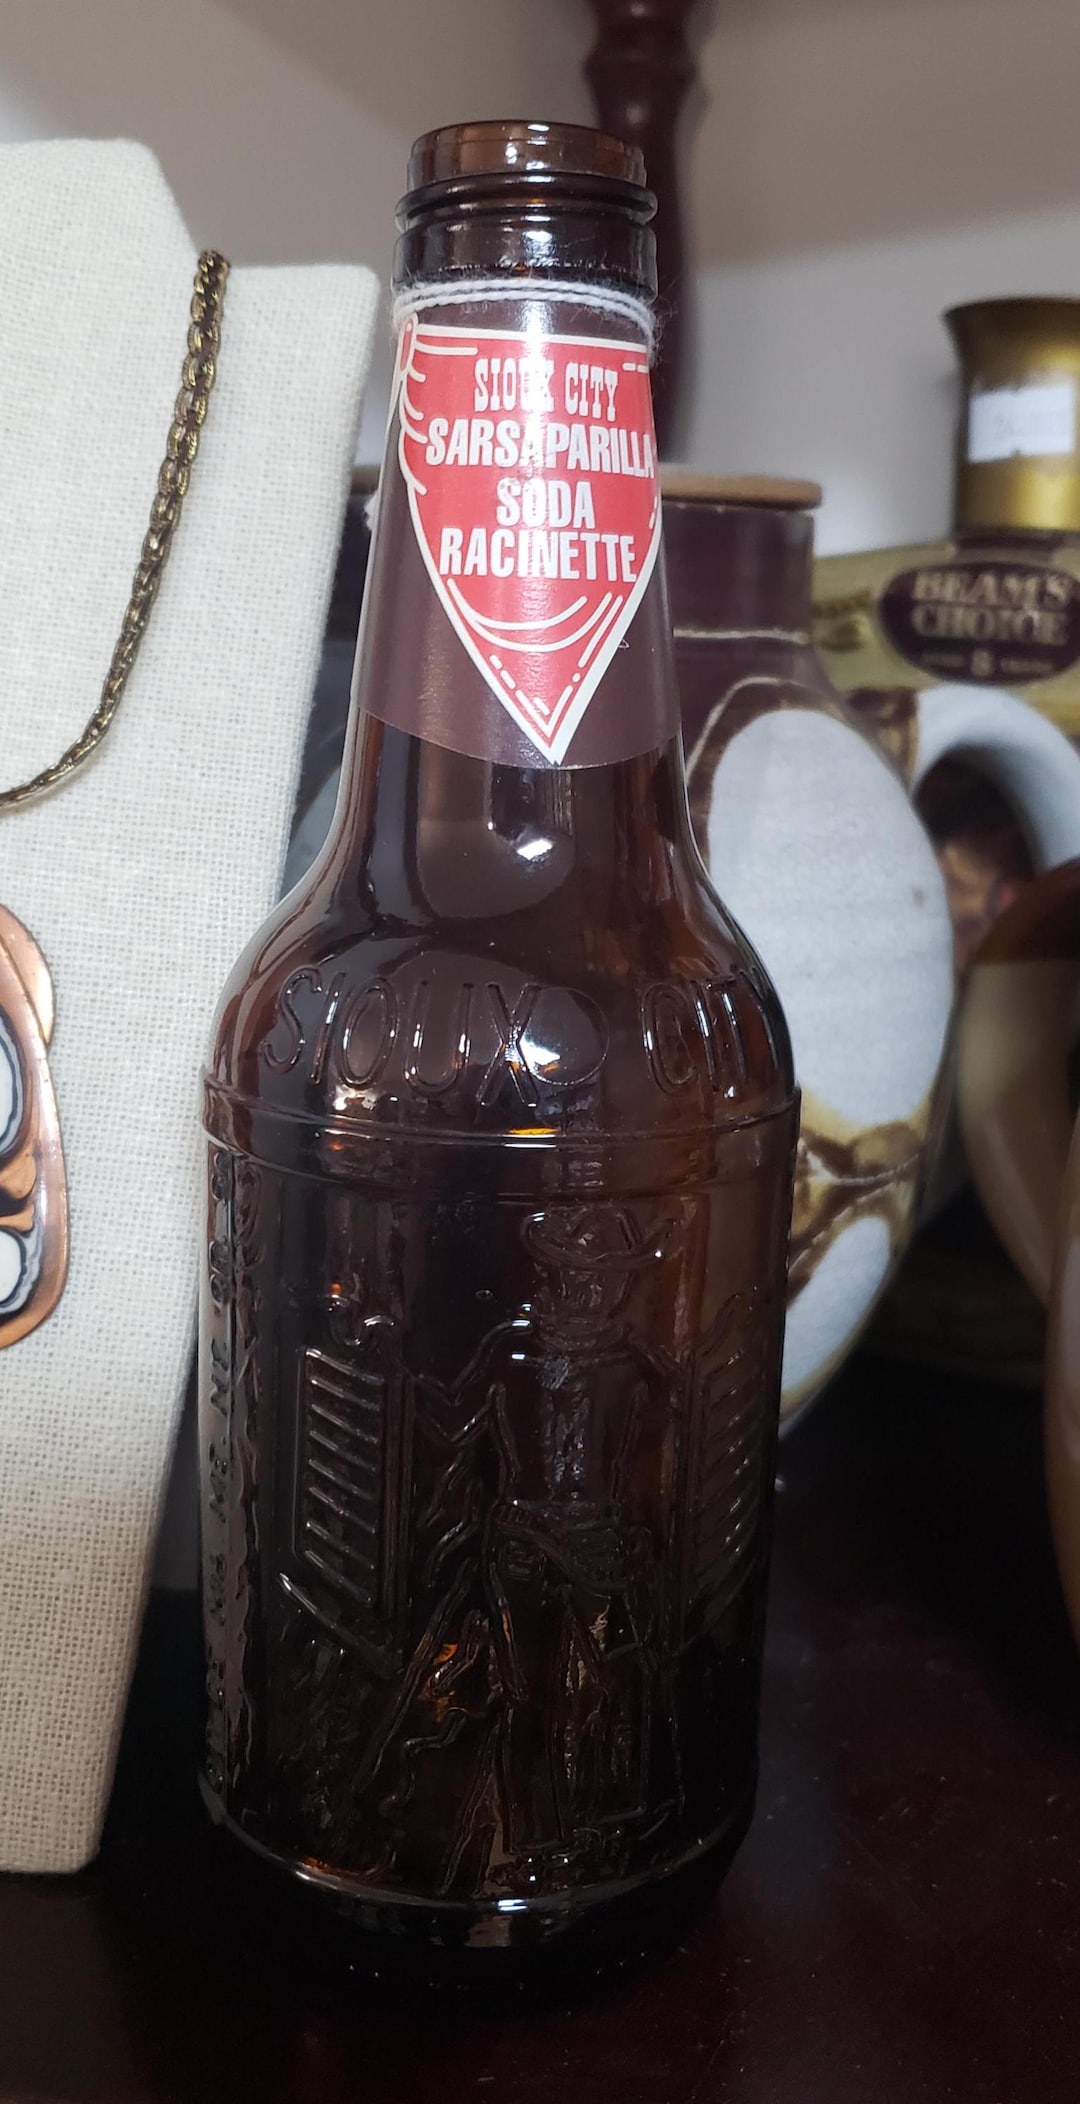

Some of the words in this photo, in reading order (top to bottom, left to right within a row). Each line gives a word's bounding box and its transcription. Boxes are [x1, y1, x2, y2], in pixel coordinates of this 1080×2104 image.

[475, 358, 554, 412] SIOUX
[566, 362, 618, 421] CITY
[425, 417, 655, 478] SARSAPARILLA
[496, 477, 594, 529] SODA
[439, 527, 637, 583] RACINETTE
[911, 604, 1069, 646] CHOICE
[262, 966, 543, 1106] SIOUX
